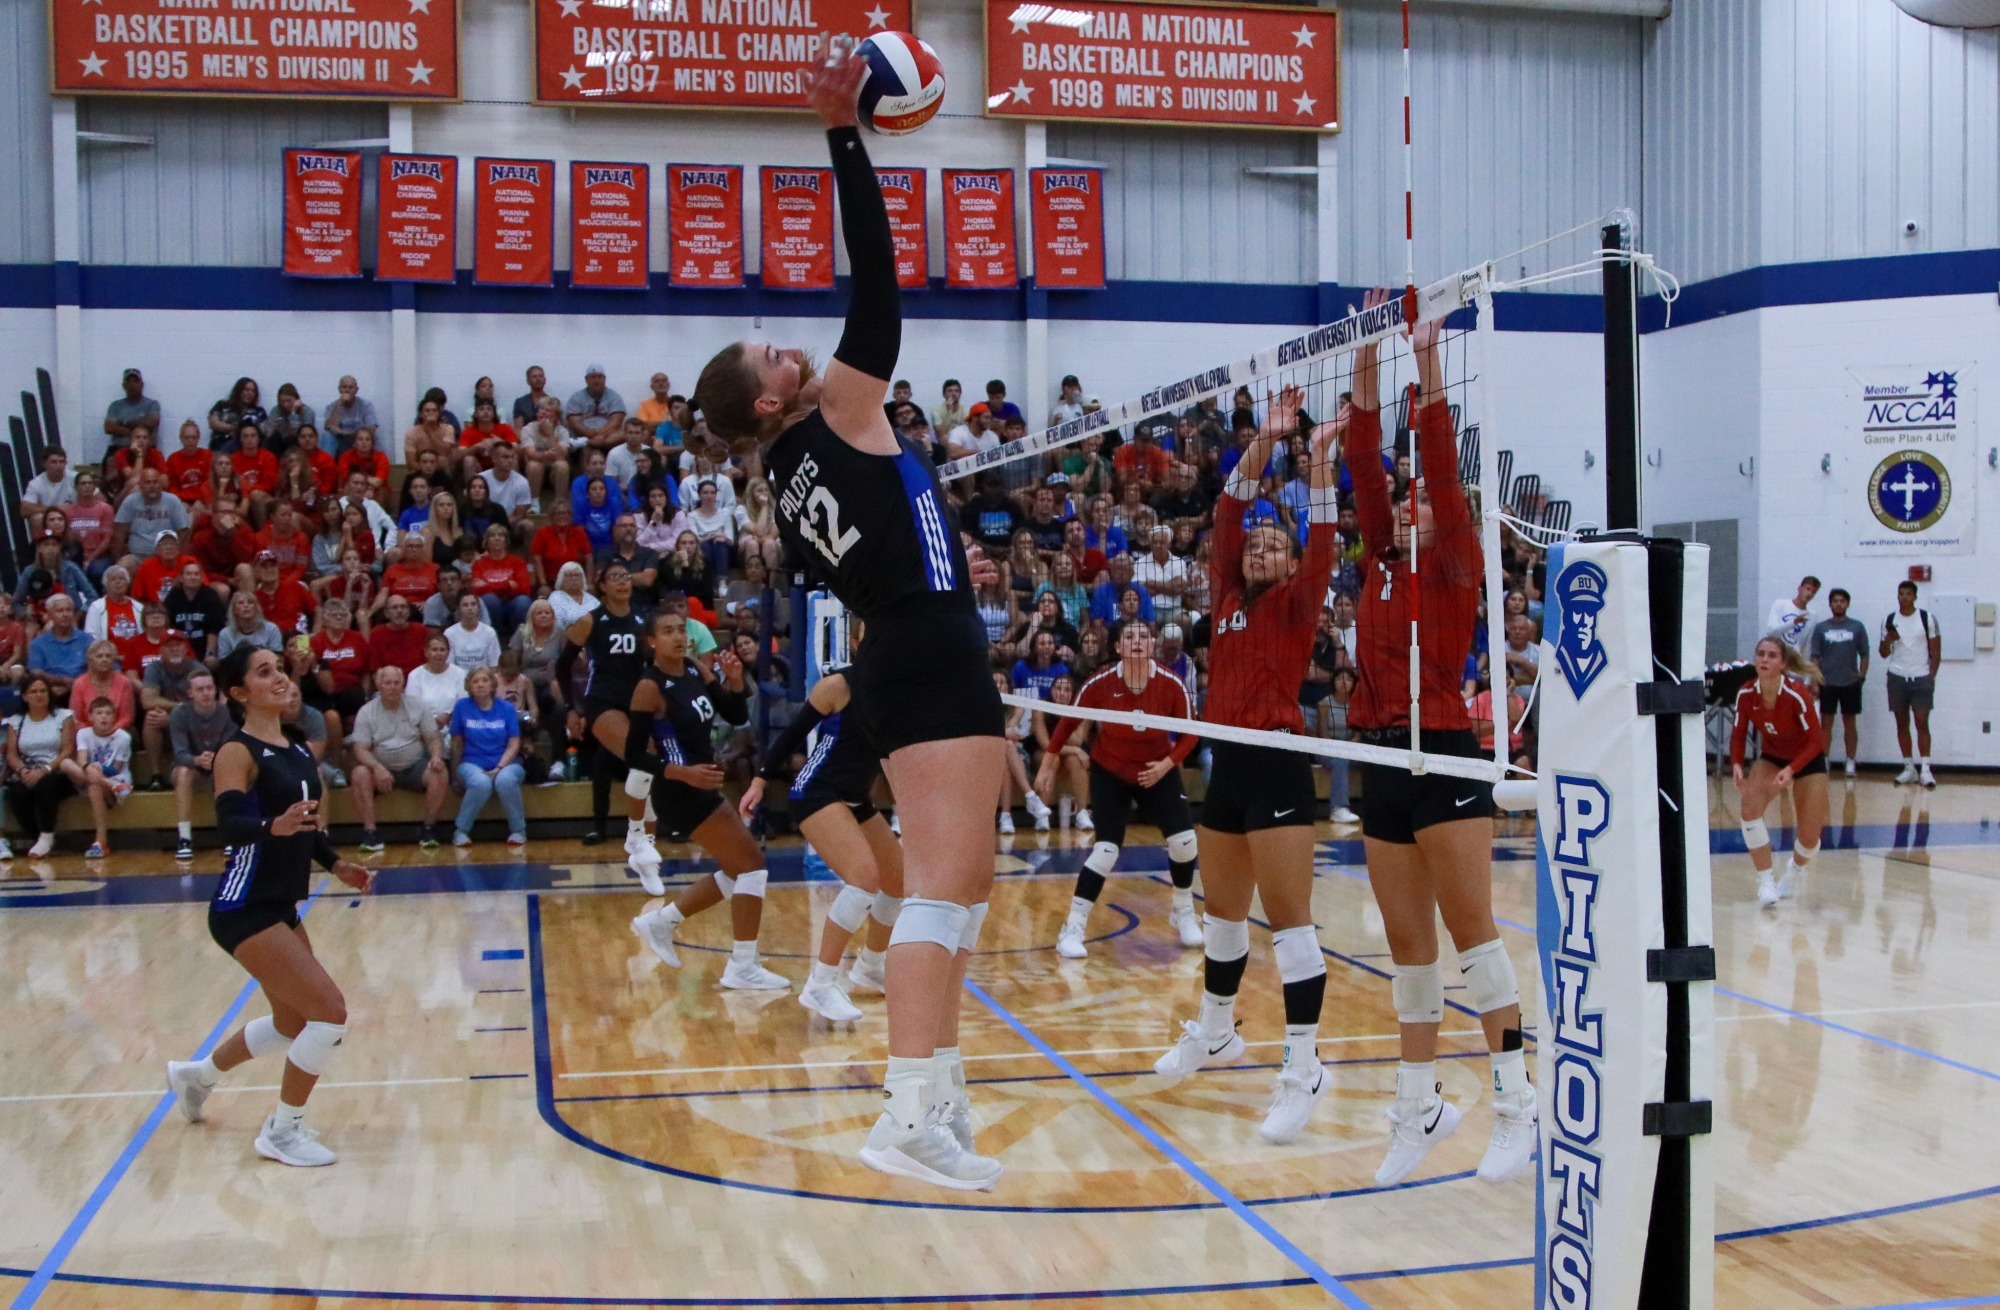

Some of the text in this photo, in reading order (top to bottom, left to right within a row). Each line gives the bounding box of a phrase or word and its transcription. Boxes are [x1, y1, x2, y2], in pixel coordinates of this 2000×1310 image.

[702, 0, 818, 28] NATIONAL
[95, 14, 418, 51] BASKETBALL CHAMPIONS
[1078, 11, 1249, 47] NAIA NATIONAL
[573, 26, 727, 60] BASKETBALL
[125, 50, 389, 82] 1995 MEN'S DIVISION II
[1022, 42, 1303, 83] BASKETBALL CHAMPIONS
[605, 60, 813, 95] 1997 MEN'S DIVISI
[1050, 78, 1278, 113] 1998 MEN'S DIVISION II
[297, 155, 349, 177] NAIA
[392, 160, 443, 183] NAIA
[489, 164, 540, 187] NAIA
[304, 180, 341, 188] NATIONAL
[398, 185, 435, 193] NATIONAL
[585, 168, 635, 190] NAIA
[681, 171, 729, 191] NAIA
[773, 173, 820, 194] NAIA
[879, 174, 913, 194] AIA
[954, 175, 1001, 195] NAIA
[1043, 174, 1089, 194] NAIA
[496, 189, 532, 197] NATIONAL
[591, 192, 627, 200] NATIONAL
[388, 231, 413, 239] TRACK
[1278, 299, 1406, 367] BETHEL UNIVERSITY VOLLEYBA
[1141, 363, 1231, 413] BETHEL UNIVERSITY VOLLEYBALL
[1864, 385, 1909, 395] Member
[1867, 400, 1955, 423] NCCAA
[1864, 431, 1956, 445] Game Plan 4 Life
[1900, 452, 1923, 461] LOVE
[779, 452, 819, 523] PILOTS
[1871, 464, 1888, 515] EXCELLENCE
[1936, 473, 1951, 516] INTEGRITY
[1897, 522, 1920, 530] FAITH
[1577, 576, 1592, 589] BU
[609, 633, 636, 654] 20
[691, 695, 714, 723] 13
[1764, 721, 1779, 736] 2
[1549, 768, 1611, 1310] PILOTS
